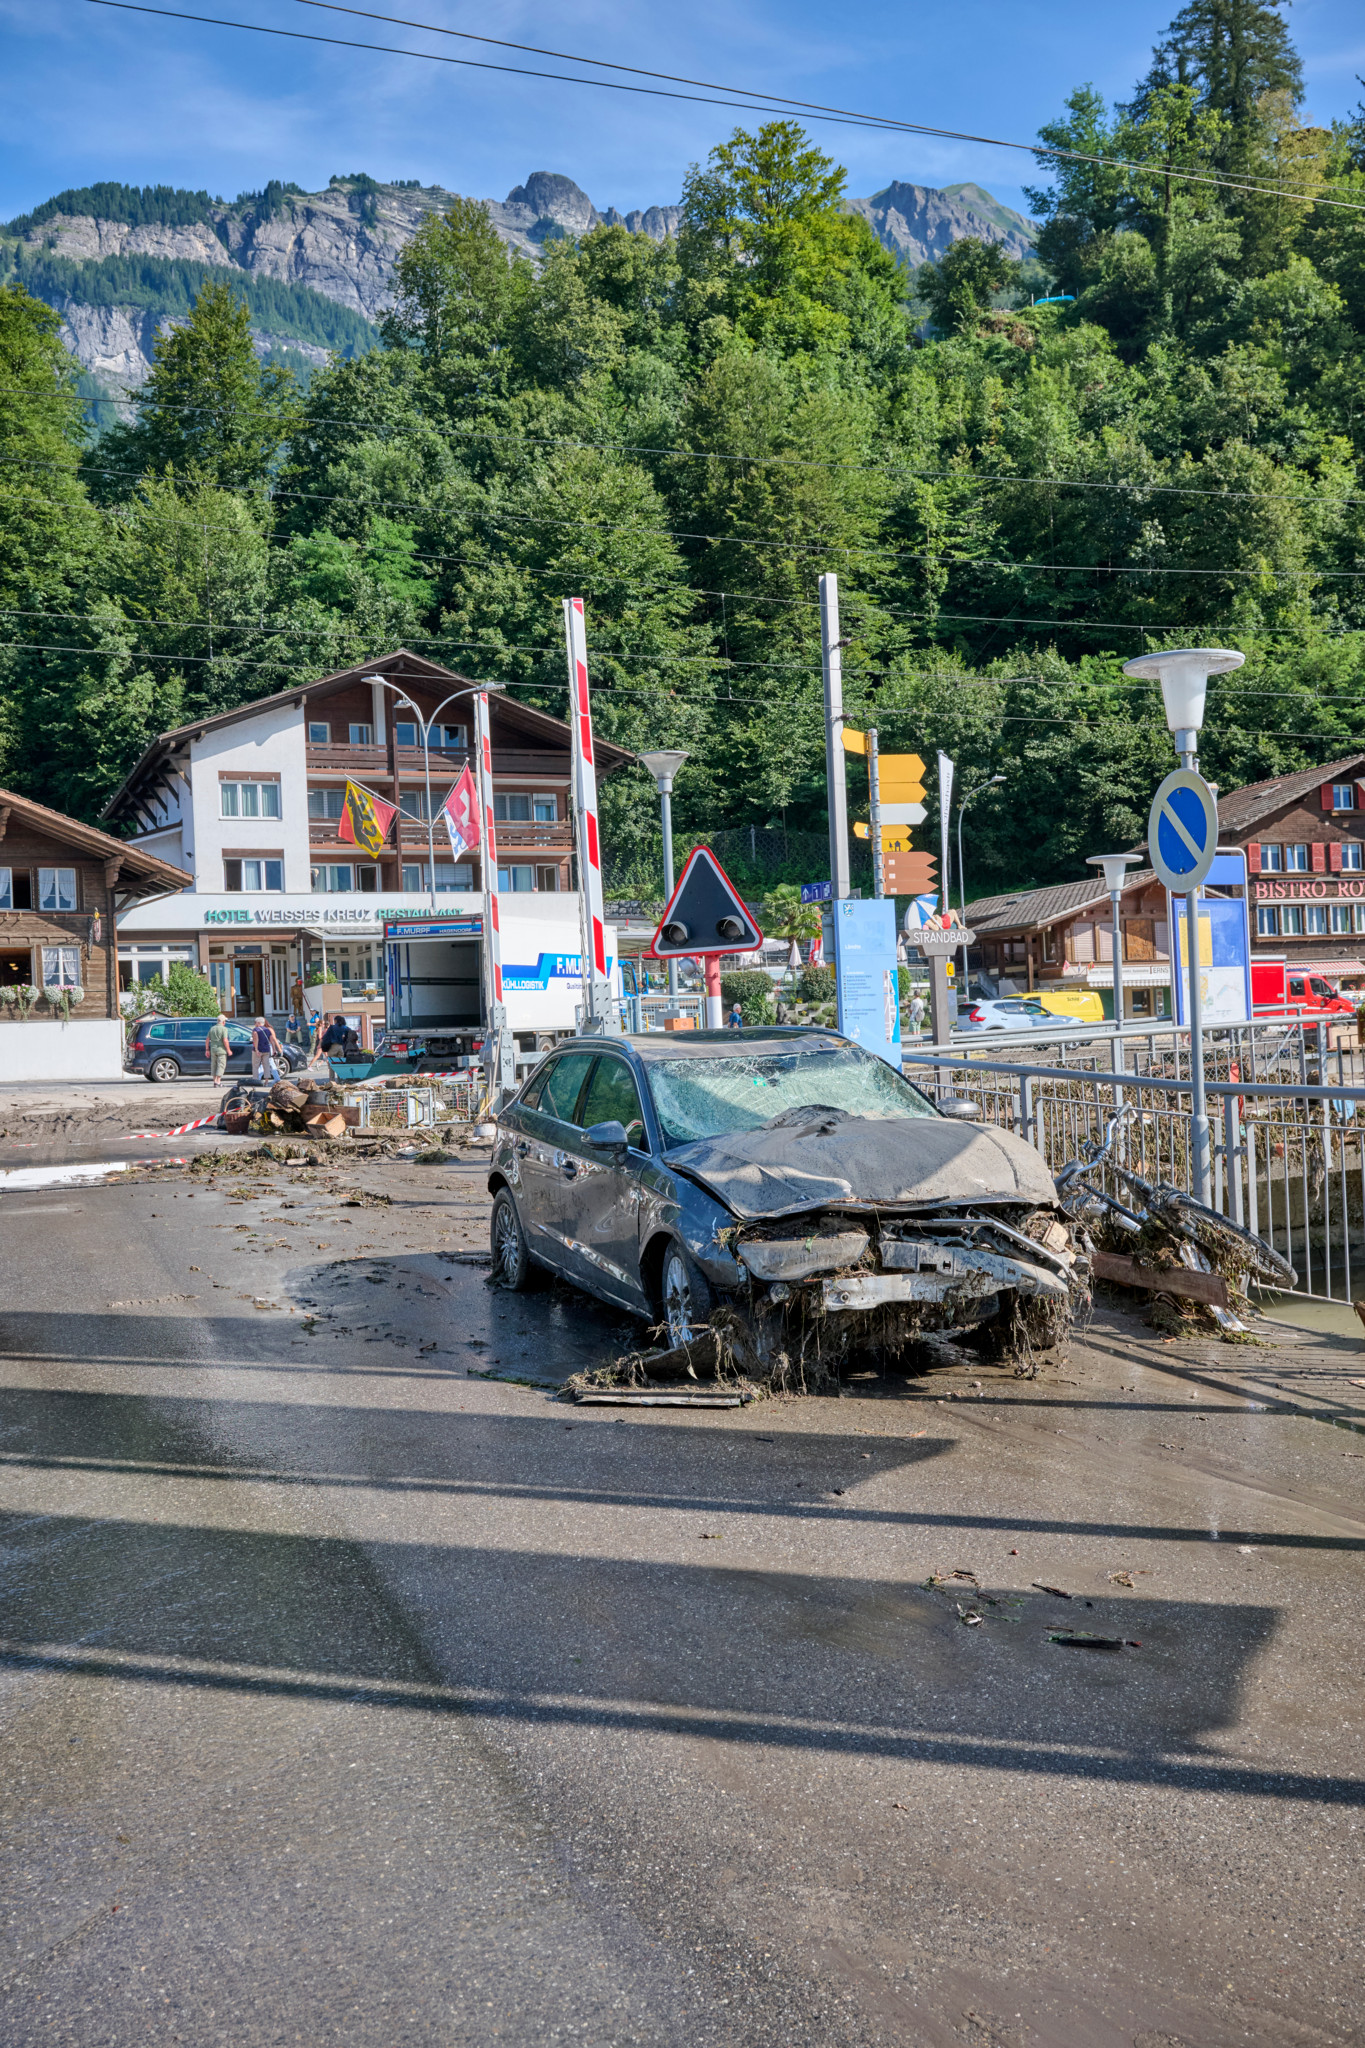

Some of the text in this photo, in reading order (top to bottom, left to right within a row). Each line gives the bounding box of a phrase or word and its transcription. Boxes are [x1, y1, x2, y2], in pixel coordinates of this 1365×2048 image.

[1254, 880, 1365, 899] BISTRO RO
[207, 909, 254, 921] HOTEL
[258, 909, 321, 921] WEISSES
[327, 909, 371, 920] KREUZ
[913, 932, 969, 944] STRANDBAD
[502, 978, 545, 990] KÜHLLOGISTIK
